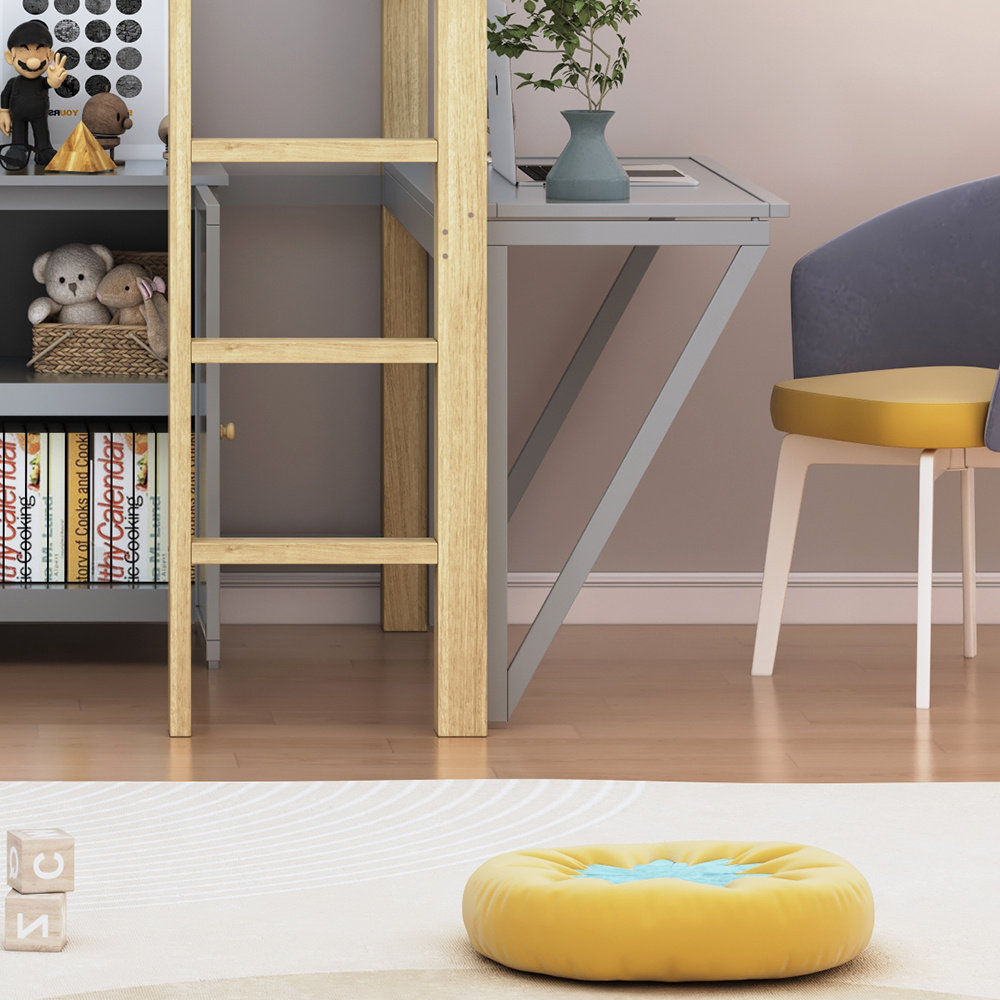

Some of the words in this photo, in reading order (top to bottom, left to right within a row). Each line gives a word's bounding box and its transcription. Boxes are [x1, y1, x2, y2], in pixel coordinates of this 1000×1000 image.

[75, 472, 88, 494] and
[97, 435, 125, 541] Calendar
[16, 495, 36, 564] Cooking
[75, 498, 88, 538] Cooks
[124, 495, 144, 563] Cooking
[75, 540, 88, 553] of
